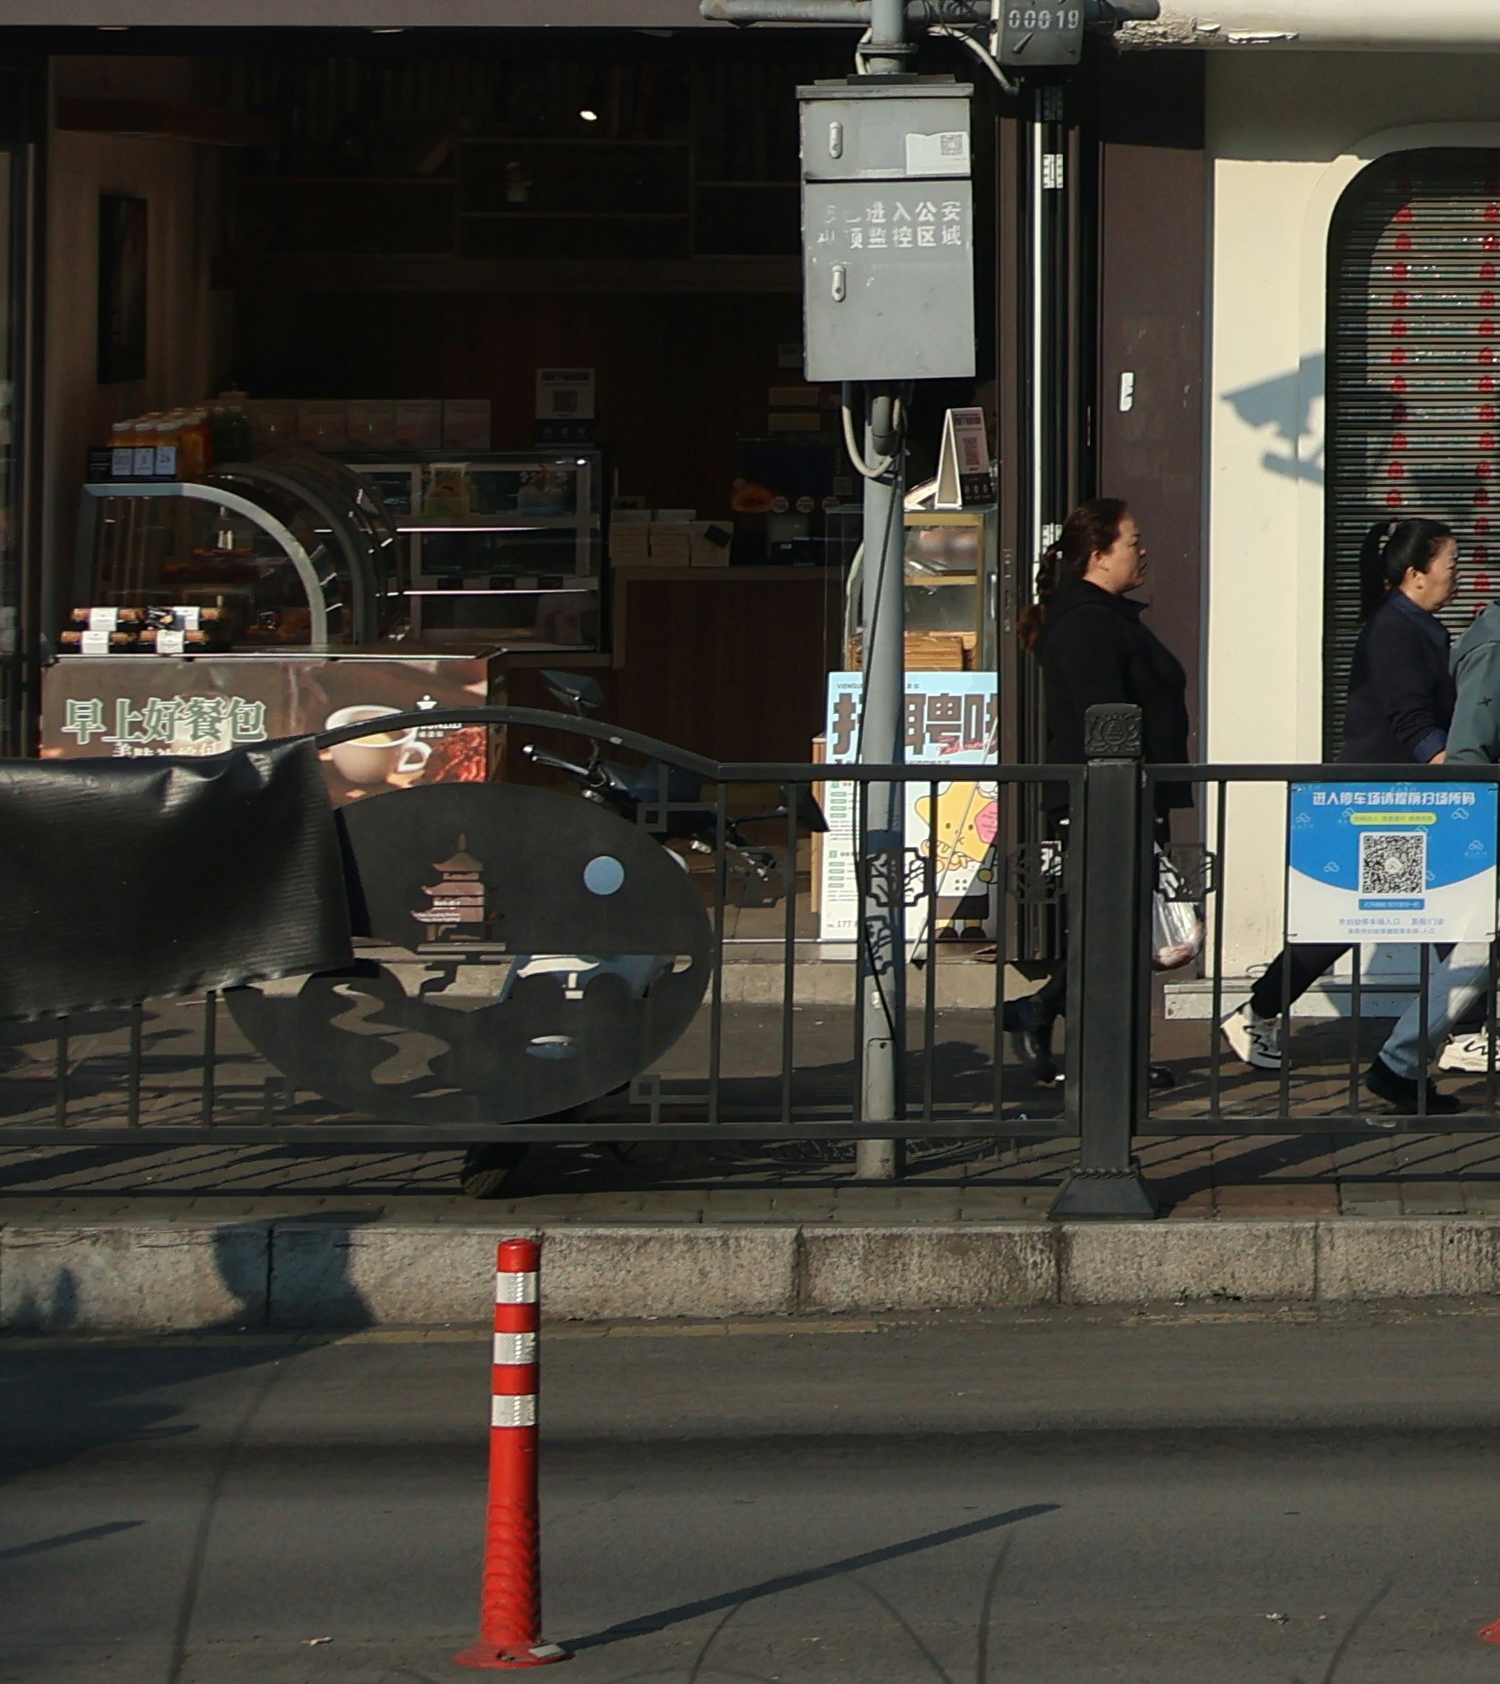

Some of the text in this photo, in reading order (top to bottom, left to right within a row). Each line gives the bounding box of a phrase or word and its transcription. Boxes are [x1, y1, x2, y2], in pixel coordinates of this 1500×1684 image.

[61, 696, 268, 746] 早上好餐包
